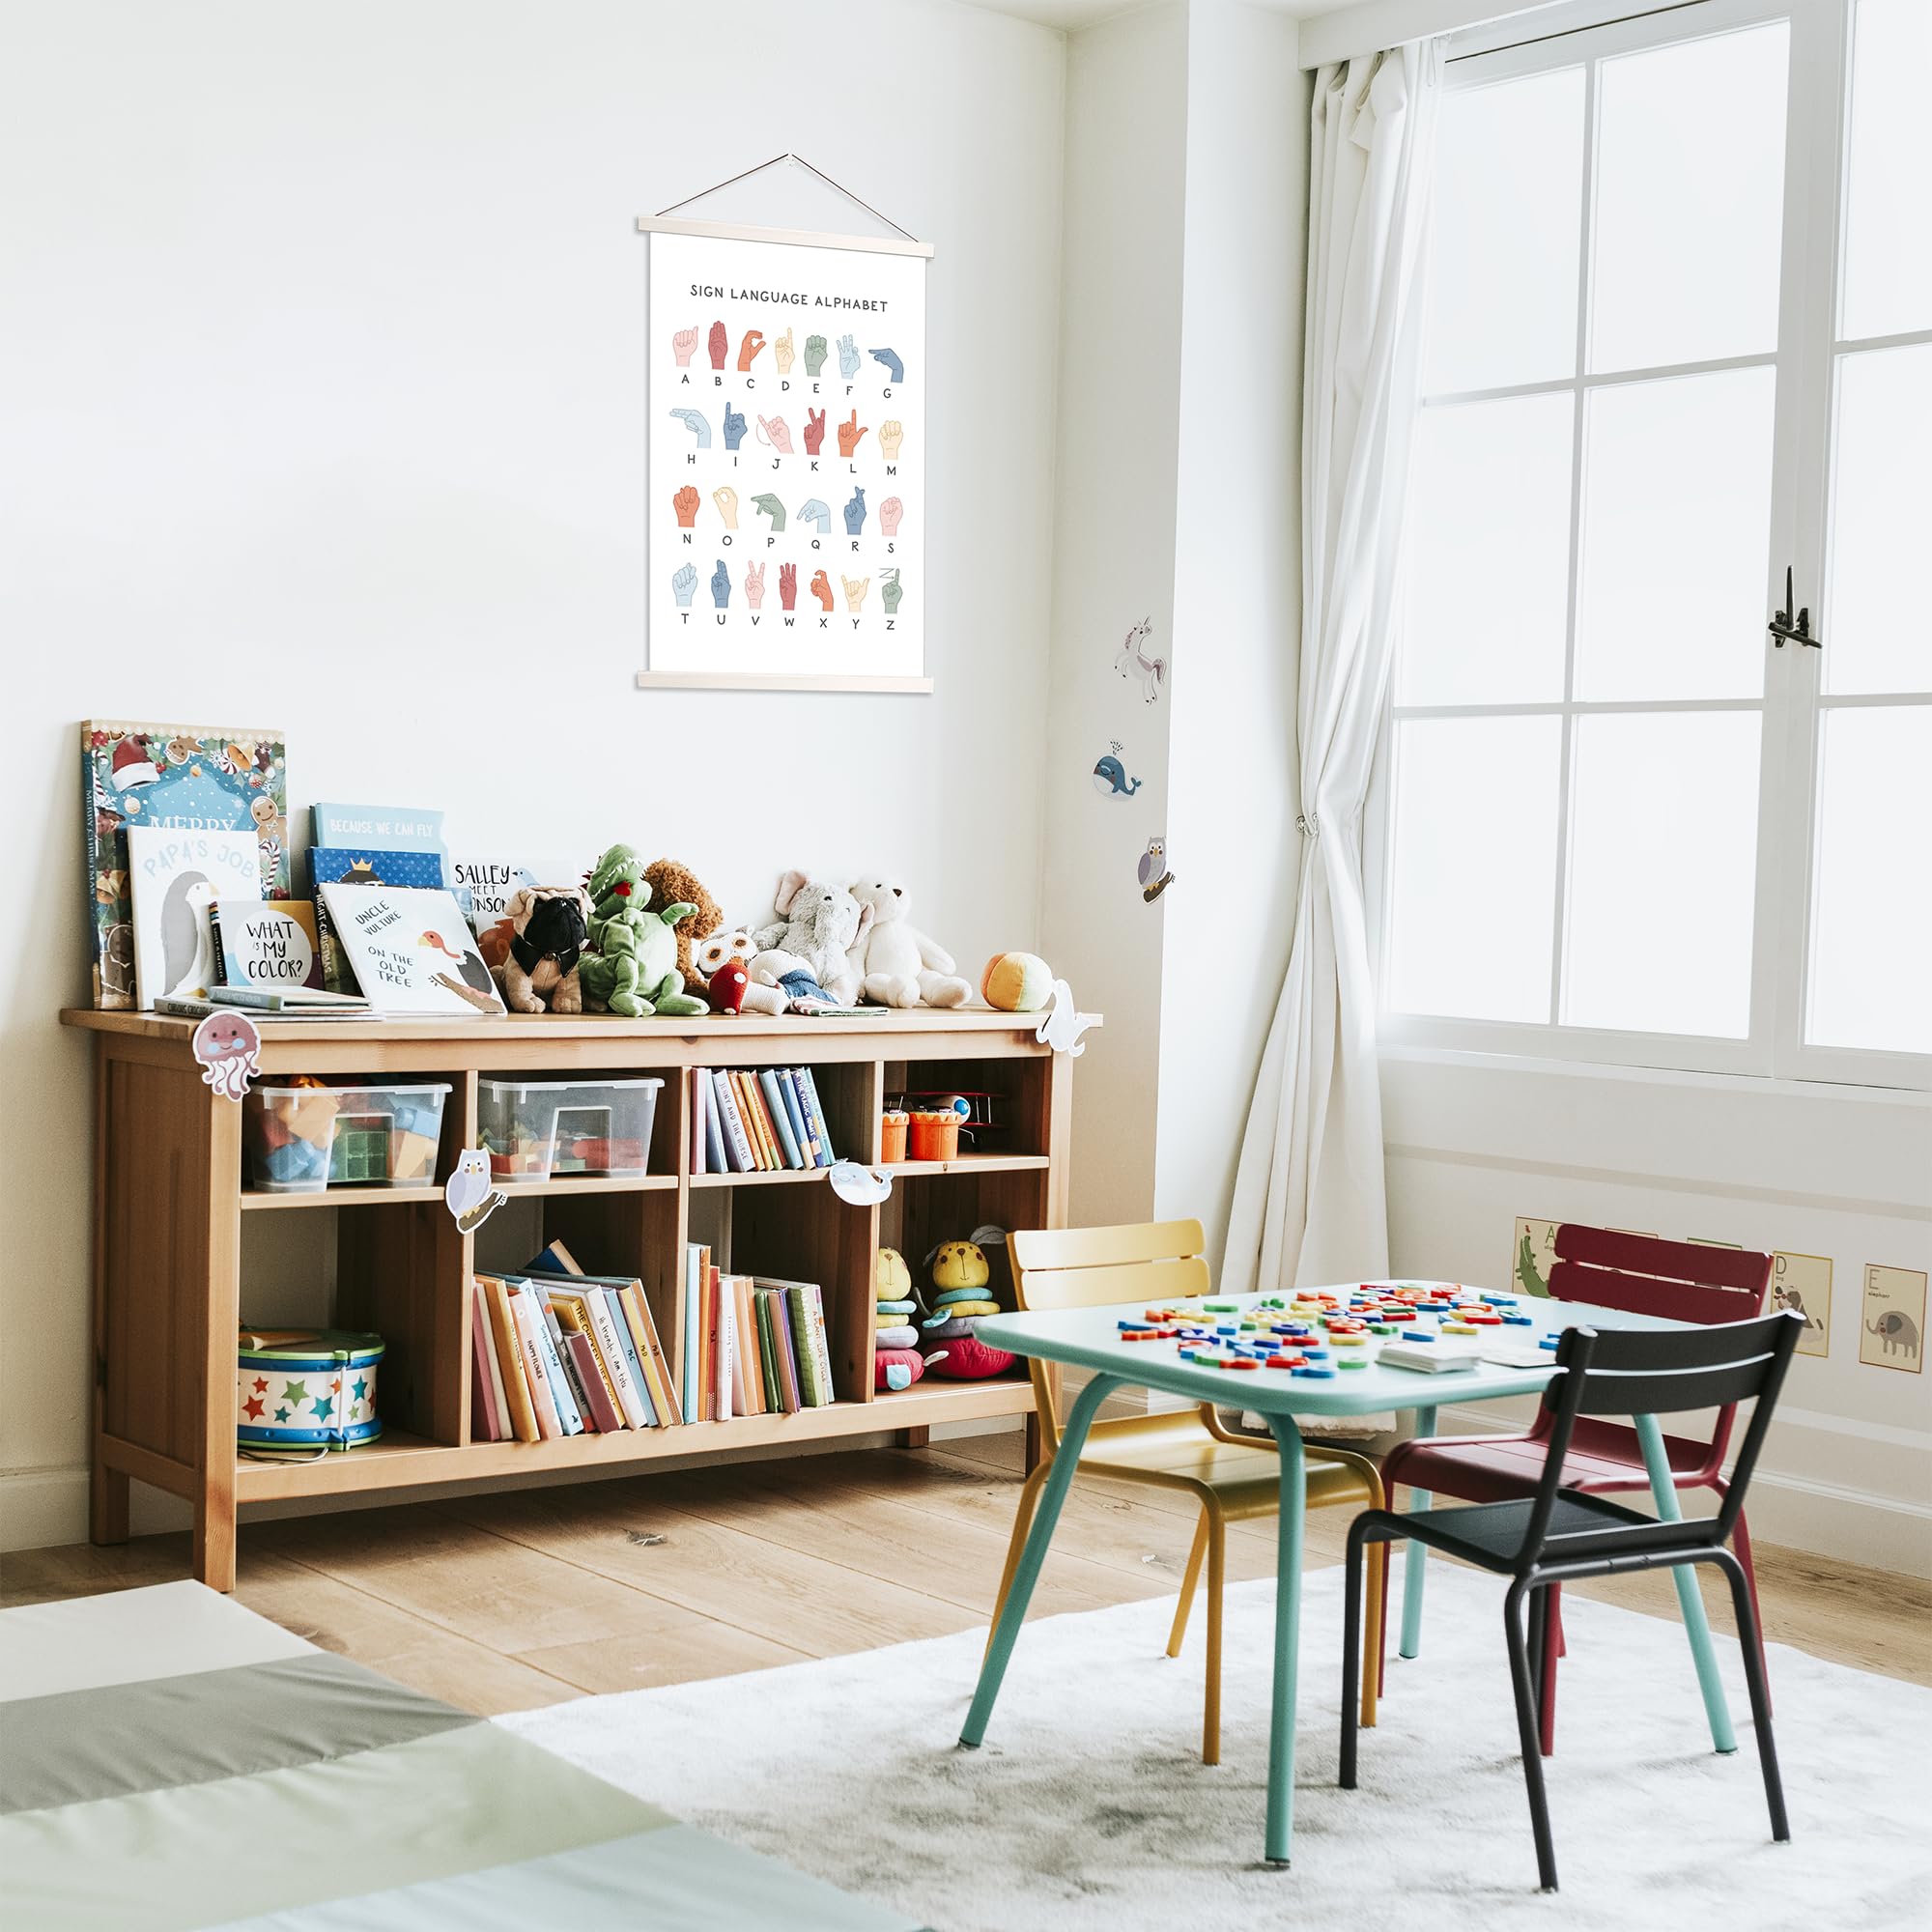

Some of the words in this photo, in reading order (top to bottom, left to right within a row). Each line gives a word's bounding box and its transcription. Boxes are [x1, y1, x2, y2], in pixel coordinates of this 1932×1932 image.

[690, 284, 724, 298] SIGN
[730, 288, 809, 305] LANGUAGE
[814, 296, 889, 313] ALPHABET
[681, 374, 690, 384] A
[714, 376, 723, 386] B
[746, 378, 755, 389] C
[781, 381, 790, 391] D
[812, 383, 820, 394] E
[846, 385, 854, 396] F
[883, 387, 892, 399] G
[687, 453, 696, 465] H
[772, 458, 781, 469] J
[810, 461, 819, 471] K
[849, 463, 857, 473] L
[887, 465, 896, 476] M
[683, 533, 692, 545] N
[722, 535, 733, 547] O
[767, 537, 775, 548] P
[810, 539, 821, 551] Q
[851, 540, 860, 552] R
[887, 542, 895, 554] S
[681, 612, 690, 625] T
[717, 613, 726, 626] U
[751, 615, 760, 626] V
[783, 617, 795, 627] W
[819, 617, 828, 629] X
[852, 618, 860, 630] Y
[886, 619, 895, 631] Z
[329, 819, 373, 834] BECAUSE
[376, 821, 391, 835] WE
[394, 821, 414, 836] CAN
[416, 823, 434, 837] FLY
[144, 839, 209, 878] PAPA'S
[216, 844, 255, 879] JOB
[455, 864, 510, 885] SALLEY
[355, 899, 390, 925] UNCLE
[245, 921, 295, 939] WHAT
[363, 910, 402, 936] VULTURE
[367, 946, 385, 957] ON
[390, 952, 414, 967] THE
[248, 959, 303, 979] COLOR?
[380, 960, 407, 975] OLD
[376, 969, 412, 988] TREE
[719, 1083, 731, 1103] JENNY
[726, 1106, 736, 1121] AND
[732, 1122, 741, 1136] THE
[737, 1138, 748, 1160] HORSE
[1545, 1225, 1555, 1244] A
[1776, 1255, 1787, 1275] D
[1869, 1268, 1881, 1291] E
[576, 1306, 586, 1323] THE
